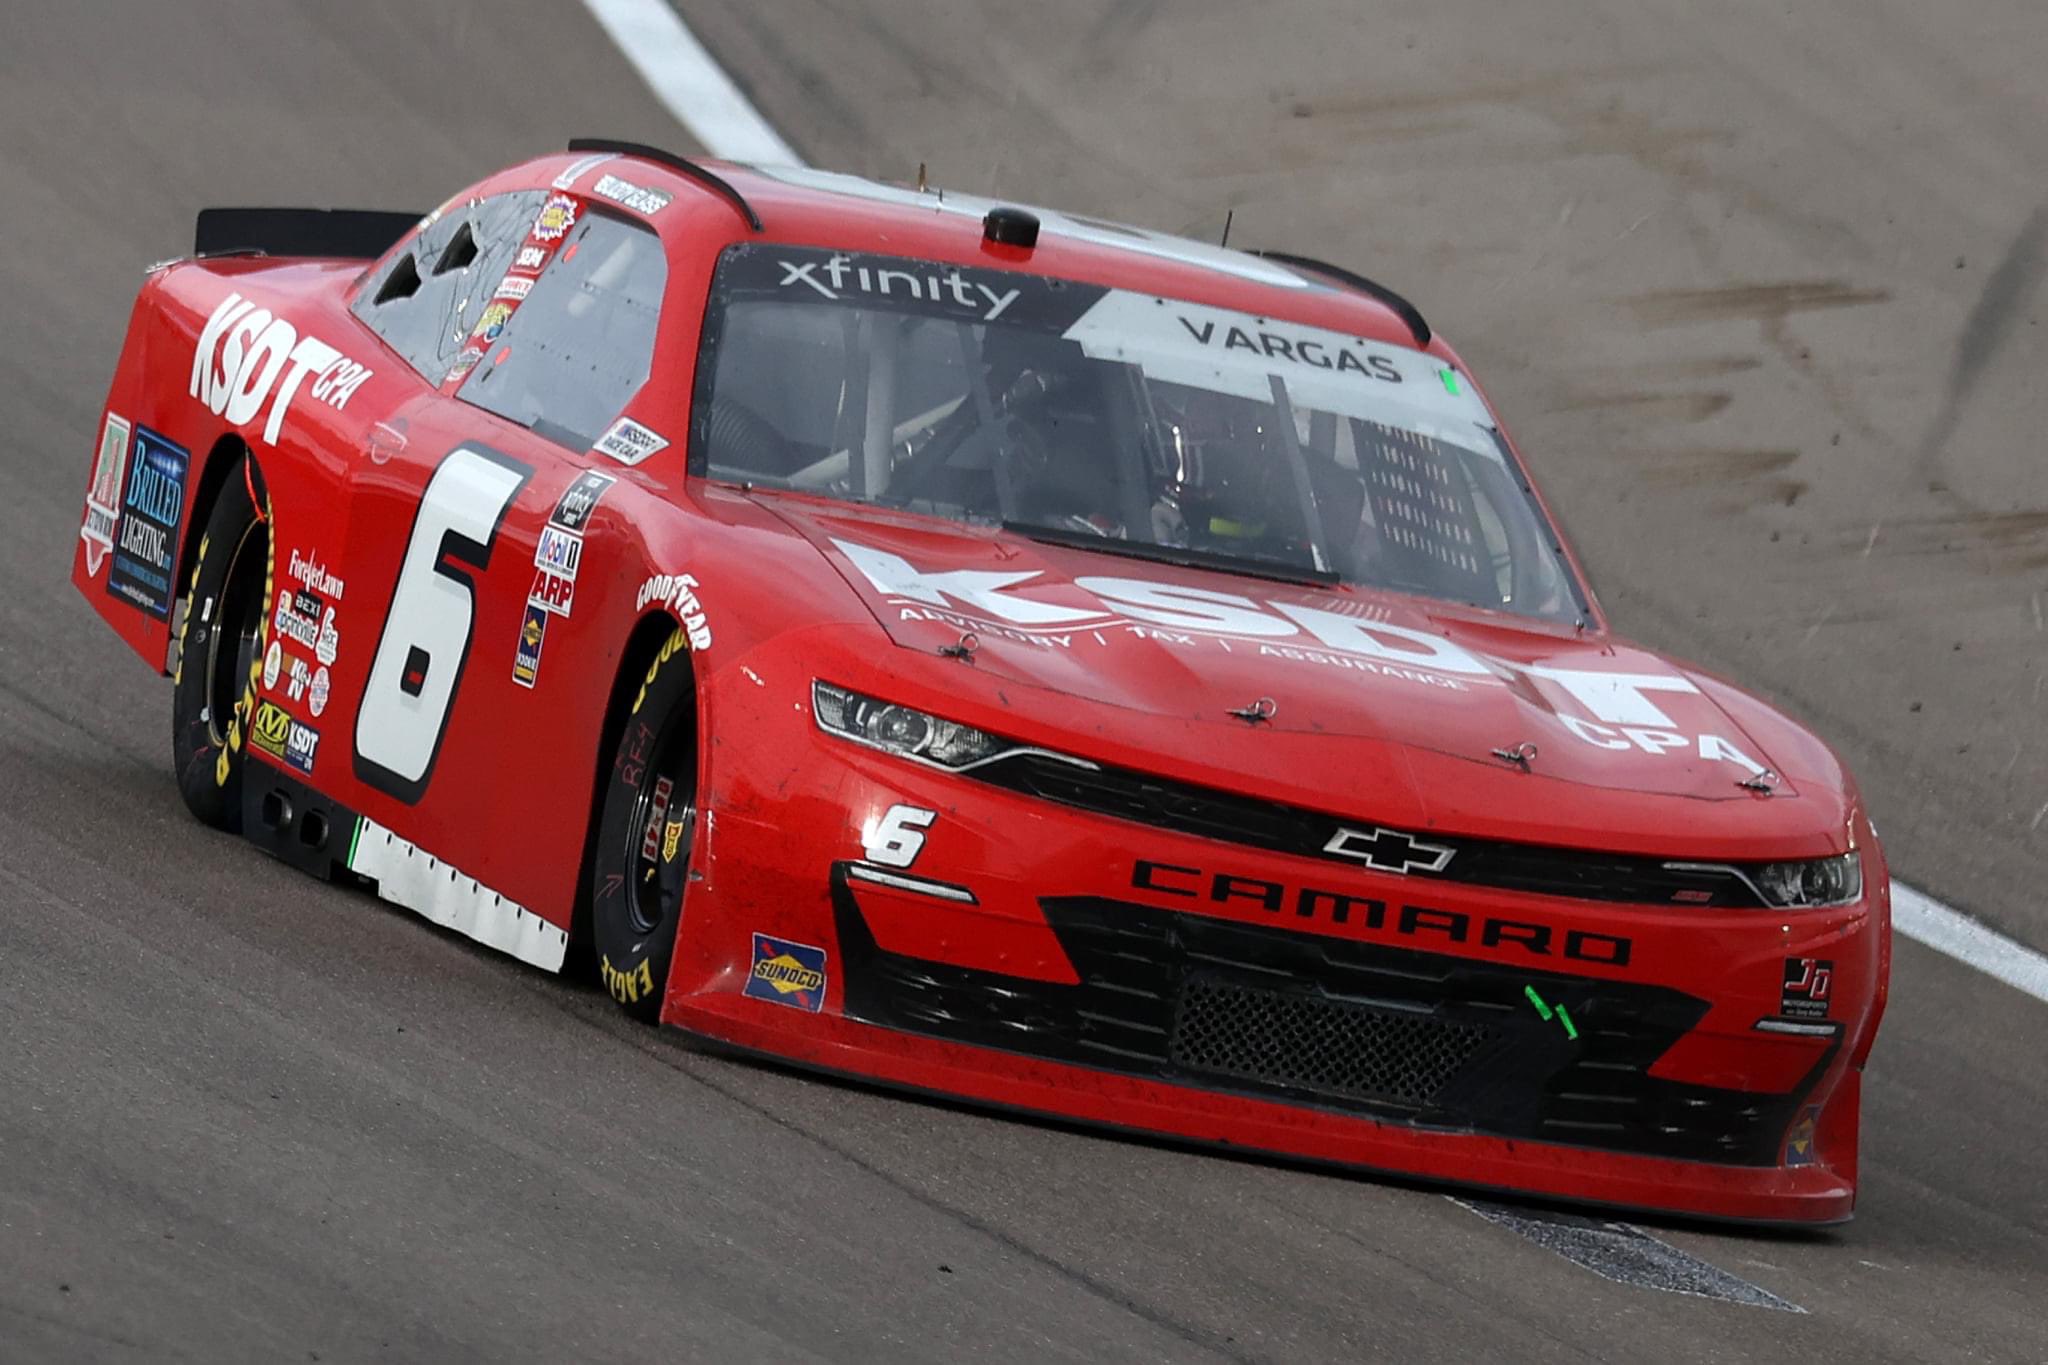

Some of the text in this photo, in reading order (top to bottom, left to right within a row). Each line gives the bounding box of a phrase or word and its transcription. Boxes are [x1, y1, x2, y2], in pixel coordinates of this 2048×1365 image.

[779, 257, 1021, 320] xfinity
[190, 293, 373, 446] KSDT CPA
[1178, 315, 1401, 384] VARGAS
[127, 439, 182, 527] BRILLED
[120, 513, 168, 569] LIGHTING
[353, 445, 527, 790] 6
[531, 571, 574, 608] ARP
[637, 573, 713, 652] GOODYEAR
[828, 537, 1702, 729] KSDT
[900, 606, 1072, 649] ADVISORY
[1126, 625, 1196, 646] TAX
[1260, 644, 1470, 692] ASSURANCE
[288, 719, 320, 758] KSDT
[1557, 712, 1770, 775] CPA
[861, 803, 938, 868] 6
[1131, 859, 1631, 966] CAMARO
[756, 961, 823, 990] SUNOCO
